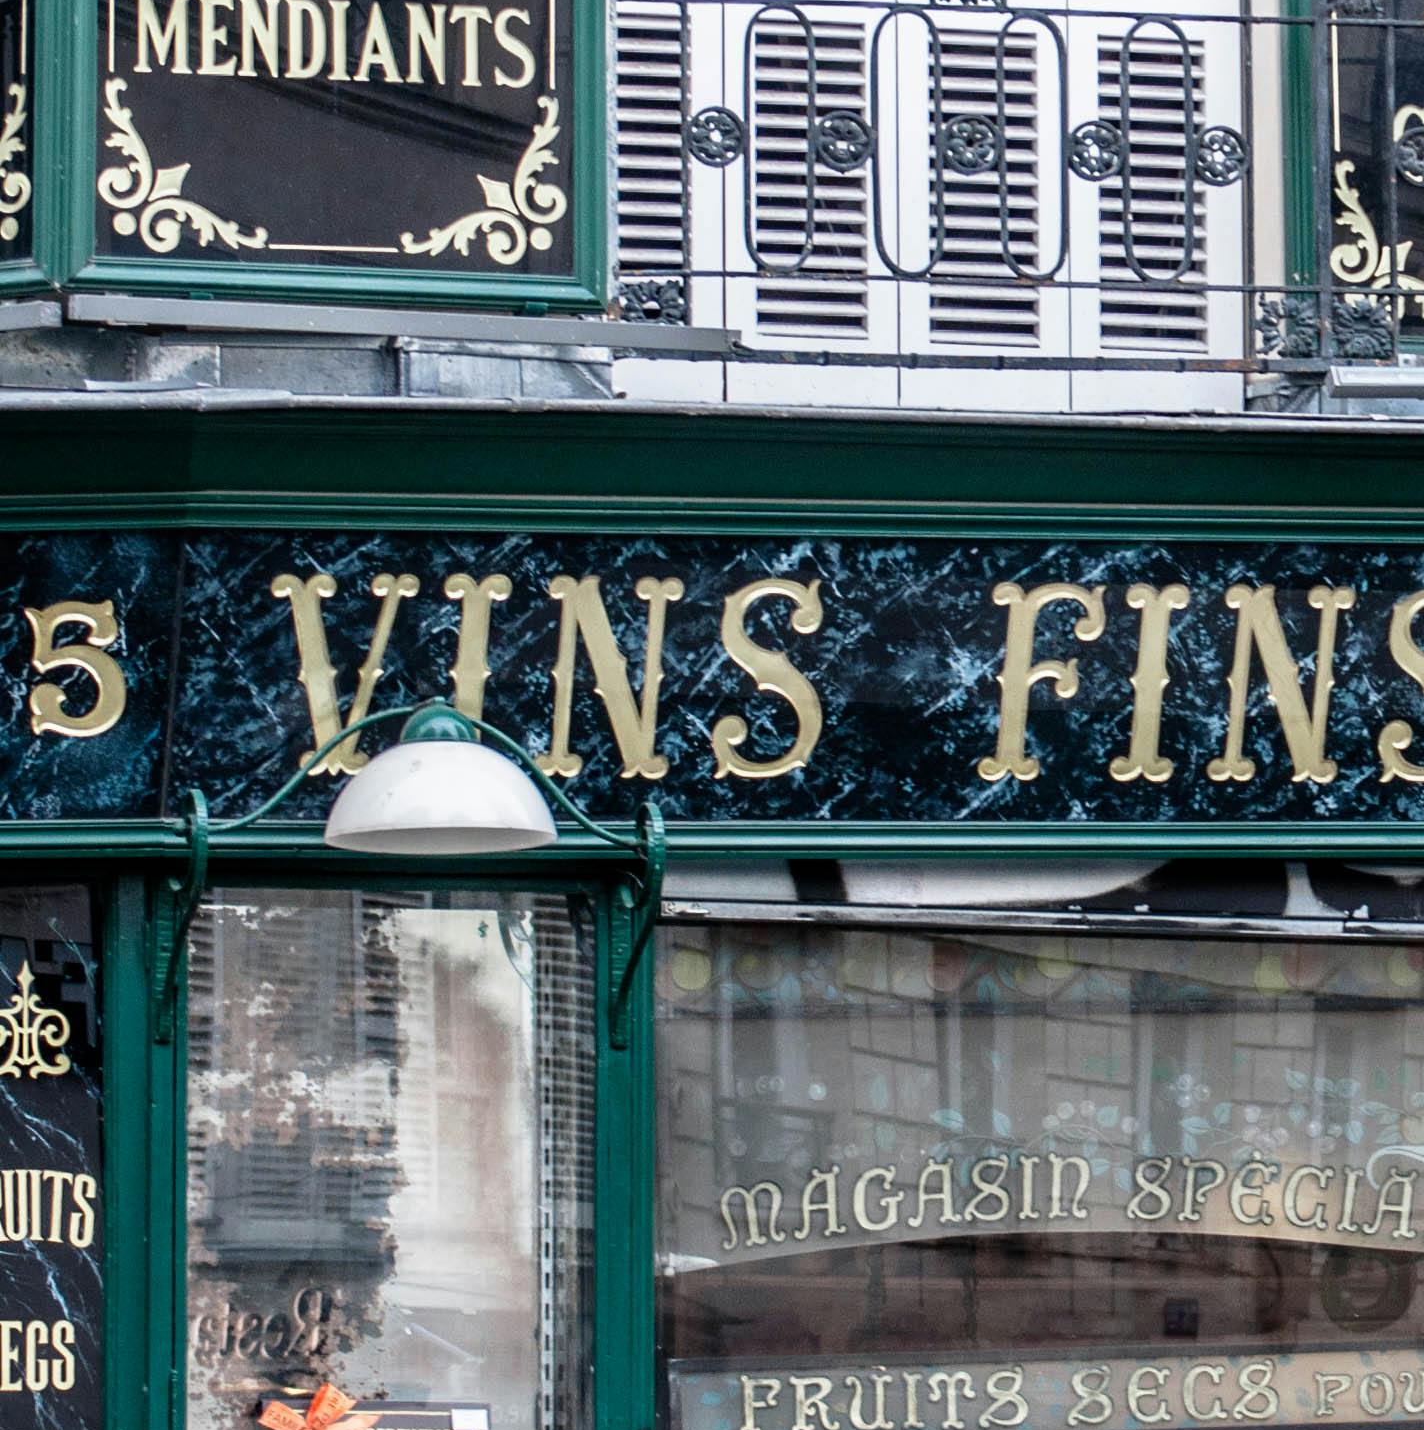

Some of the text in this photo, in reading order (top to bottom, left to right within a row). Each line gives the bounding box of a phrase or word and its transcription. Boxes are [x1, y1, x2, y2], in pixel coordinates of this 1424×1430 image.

[23, 600, 127, 738] 5
[269, 572, 825, 780] VINS
[0, 1169, 97, 1249] UITS
[719, 1153, 1092, 1252] MAGASIN
[1067, 1356, 1280, 1427] SECS
